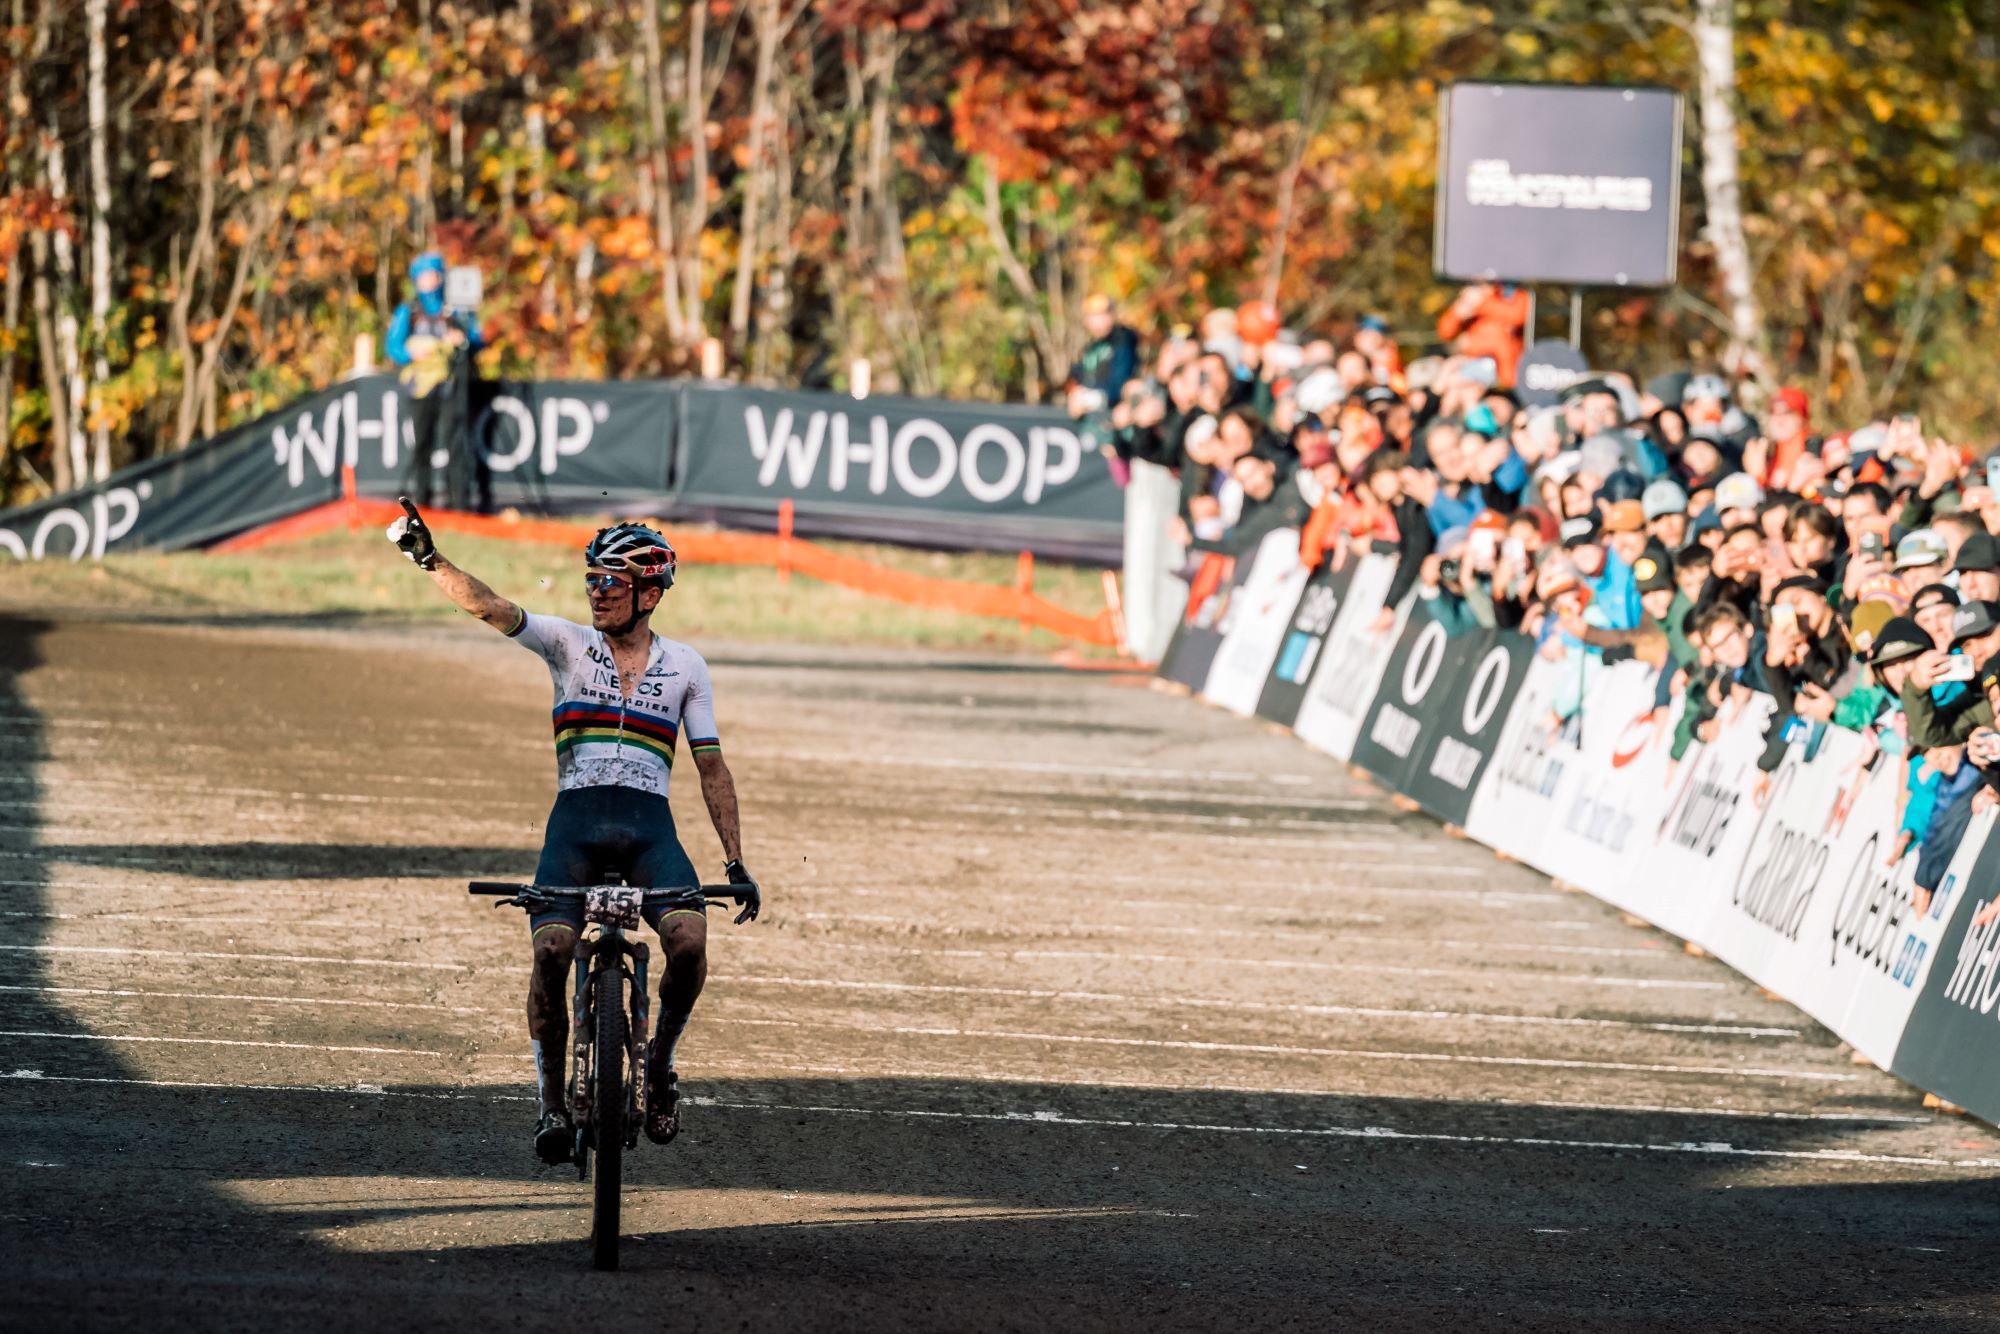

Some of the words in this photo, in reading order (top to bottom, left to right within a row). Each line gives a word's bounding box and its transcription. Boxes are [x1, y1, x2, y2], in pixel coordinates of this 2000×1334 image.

[272, 390, 597, 488] WHOP
[744, 404, 1082, 505] WHOOP
[593, 668, 663, 697] INEOS
